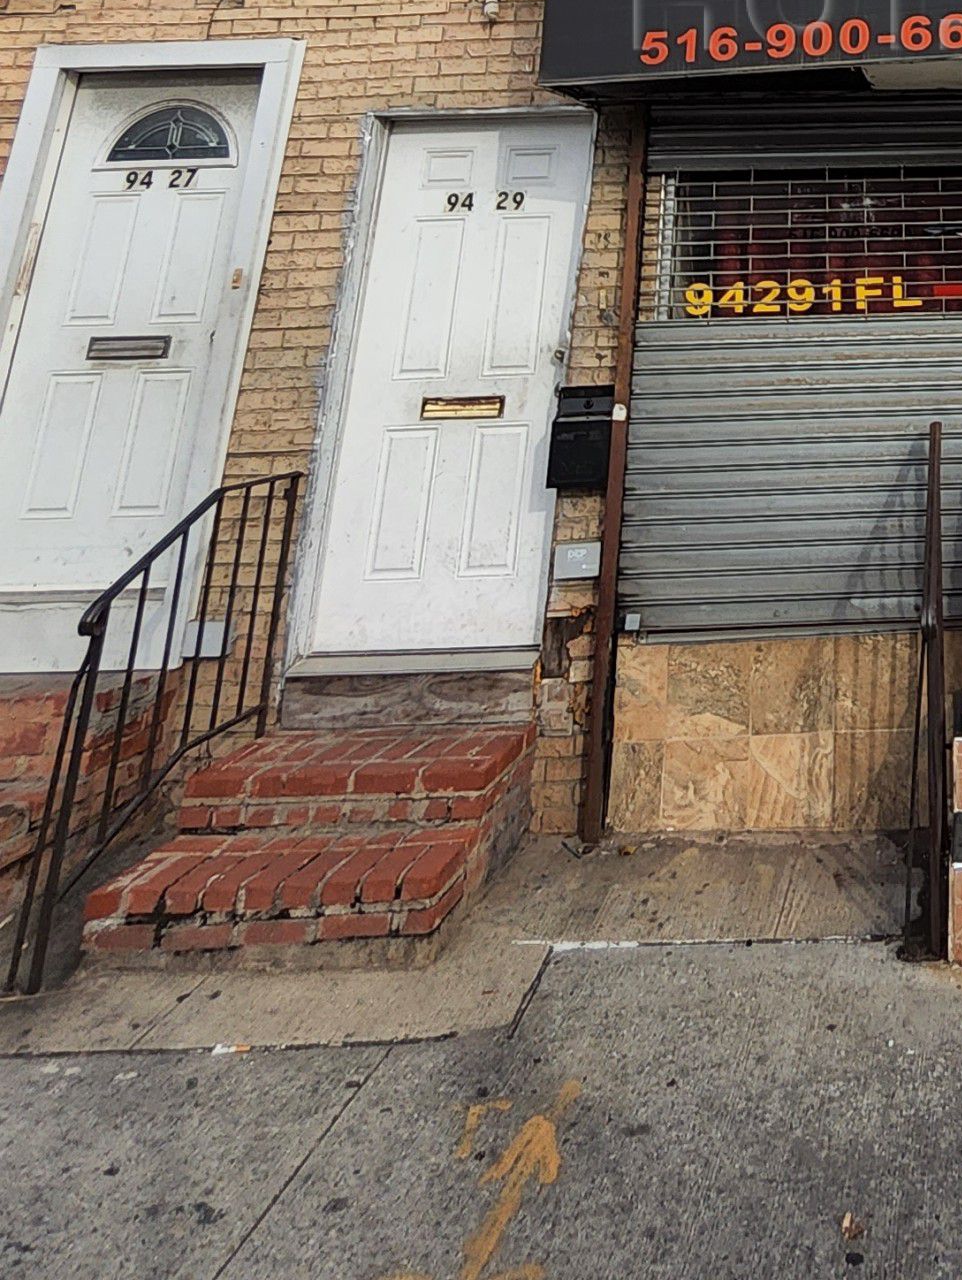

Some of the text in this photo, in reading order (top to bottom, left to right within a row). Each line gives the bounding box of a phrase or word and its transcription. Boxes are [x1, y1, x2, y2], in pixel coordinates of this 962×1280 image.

[126, 168, 199, 189] 94 27
[447, 191, 525, 211] 94 29
